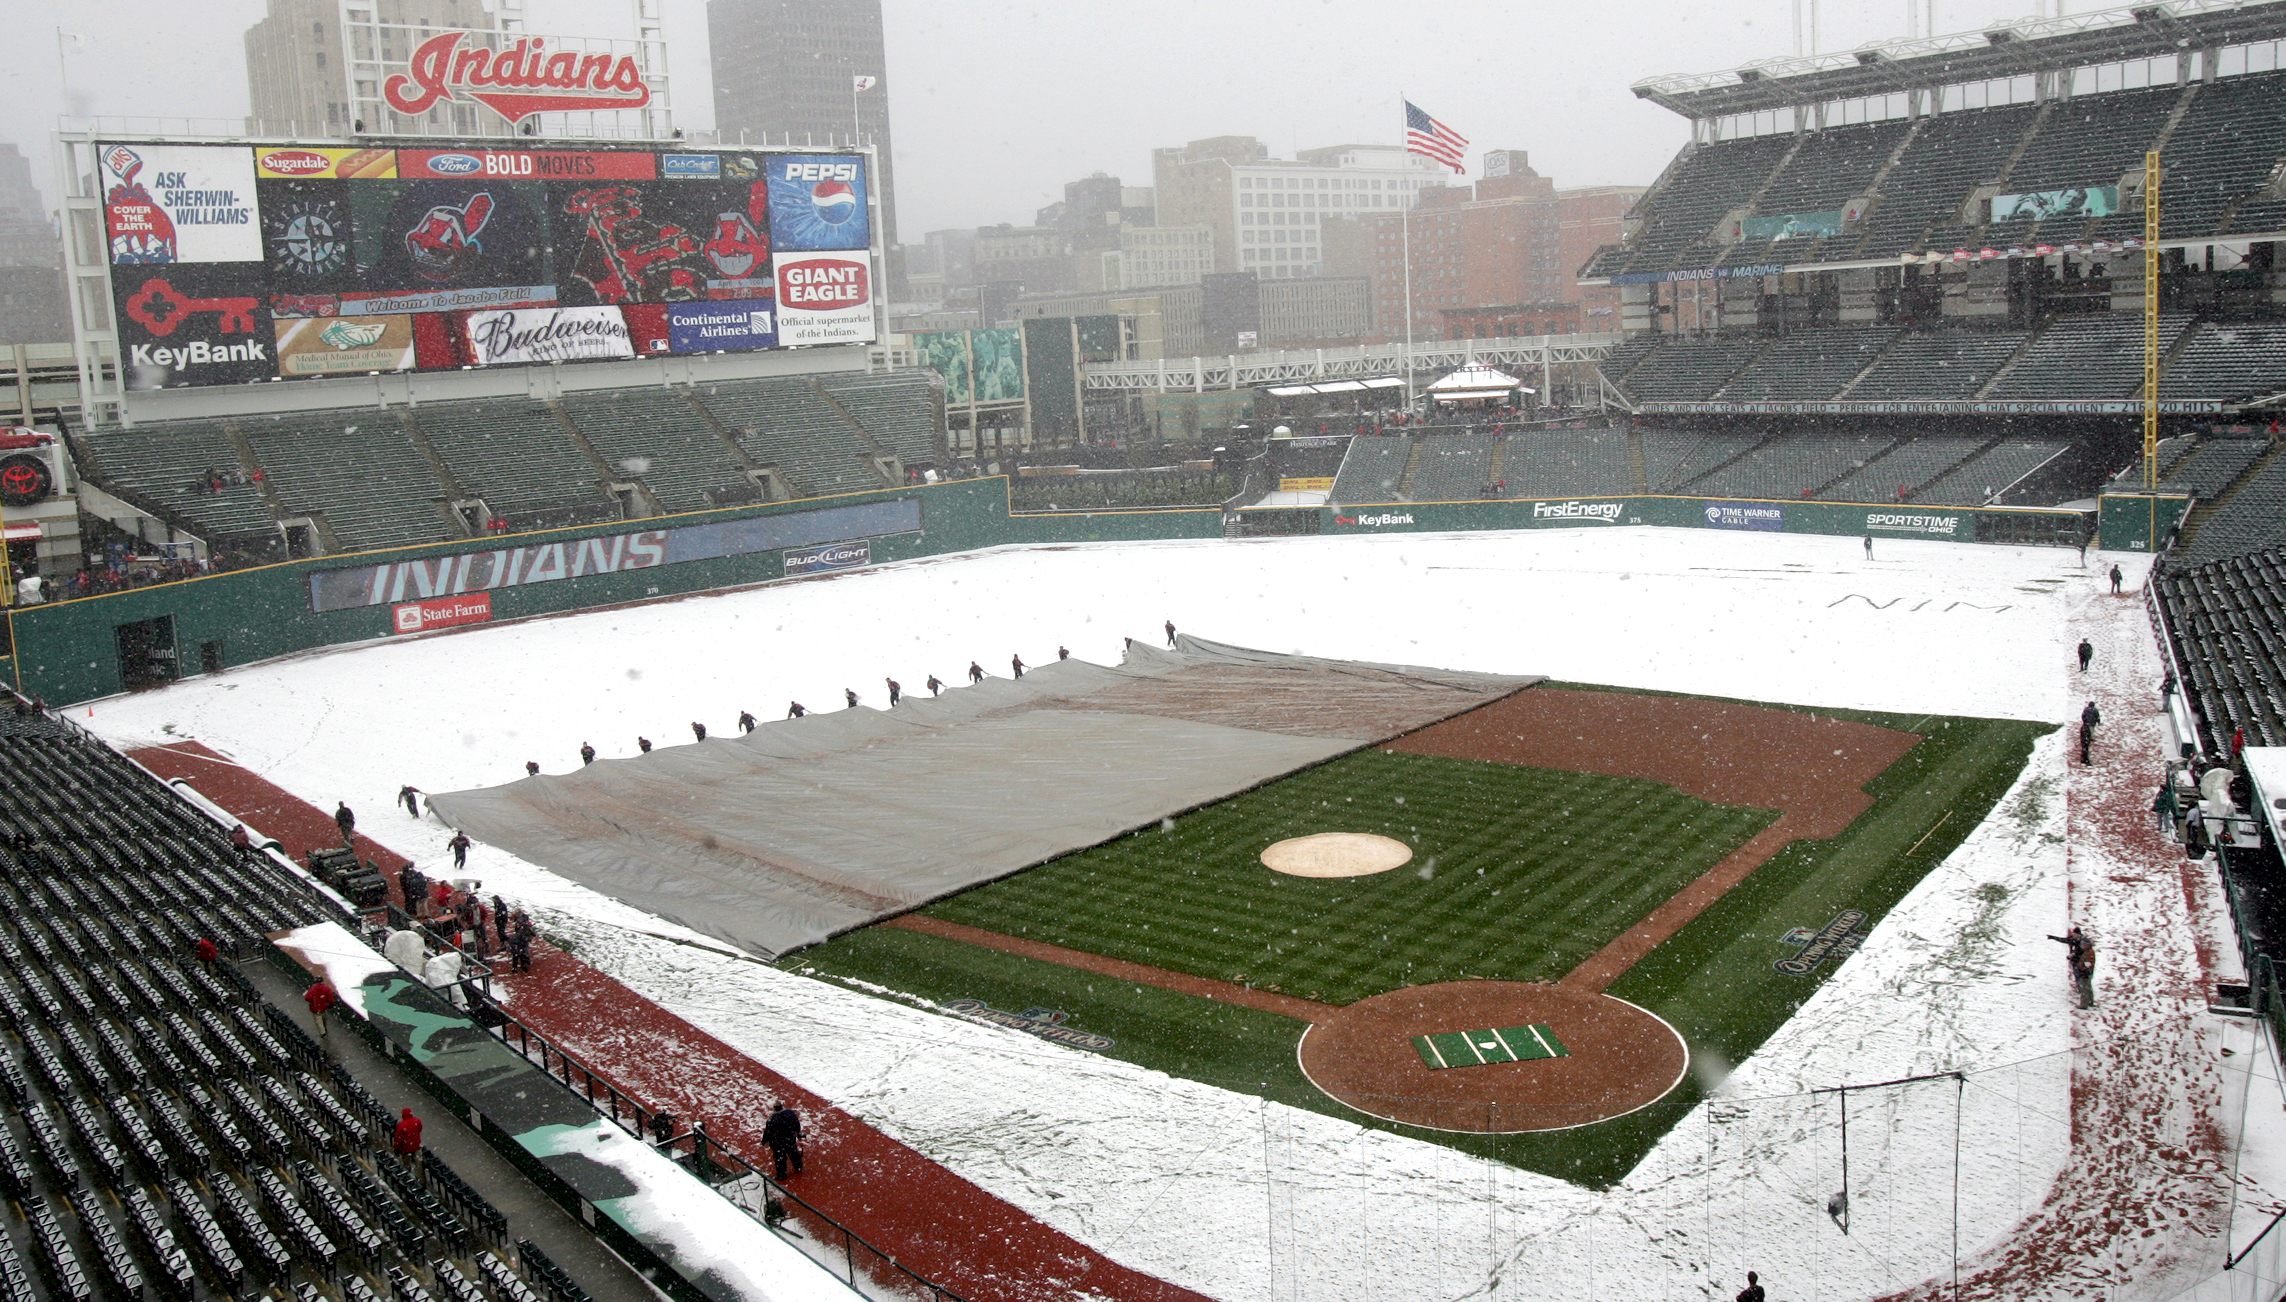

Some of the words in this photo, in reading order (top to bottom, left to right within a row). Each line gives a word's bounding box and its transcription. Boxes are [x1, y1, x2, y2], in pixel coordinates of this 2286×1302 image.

[384, 31, 650, 118] Indians
[264, 156, 329, 172] Sugardale
[438, 156, 473, 172] Ford
[486, 155, 532, 175] BOLD
[537, 156, 596, 175] MOVES
[785, 163, 858, 181] PEPSI
[155, 172, 187, 189] ASK
[164, 190, 240, 207] SHERWIN-
[113, 206, 152, 214] COVER
[176, 208, 249, 225] WILLIAMS
[274, 201, 342, 229] SEATTLE
[122, 214, 145, 222] THE
[116, 222, 153, 231] EARTH
[787, 267, 859, 285] GIANT
[1666, 268, 1714, 282] INDIANS
[366, 298, 428, 313] Welcome
[432, 295, 447, 307] To
[449, 290, 496, 305] Jacobs
[500, 287, 532, 301] Field
[790, 284, 859, 302] EAGLE
[672, 312, 748, 327] Continental
[781, 316, 814, 327] Official
[817, 314, 871, 327] supermarket
[475, 311, 629, 362] Budweiser
[700, 325, 749, 338] Airlines
[796, 329, 807, 338] of
[808, 328, 821, 337] the
[823, 327, 859, 338] Indians.
[561, 340, 575, 349] OF
[131, 339, 267, 371] KeyBank
[295, 352, 328, 364] Medical
[330, 351, 360, 362] Mutual
[362, 350, 371, 361] of
[296, 361, 323, 371] Home
[325, 360, 349, 370] Team
[1673, 404, 1691, 413] AND
[1720, 404, 1746, 413] SEATS
[1764, 404, 1798, 413] JACOBS
[1801, 404, 1827, 413] FIELD
[1839, 404, 1879, 413] PERFECT
[1883, 404, 1901, 413] FOR
[1906, 404, 1980, 413] ENTERTAINING
[1984, 404, 2011, 413] THAT
[2016, 403, 2059, 413] SPECIAL
[2066, 403, 2105, 413] CLIENT
[1533, 501, 1623, 518] FirstEnergy
[1722, 507, 1743, 517] TIME
[1743, 508, 1781, 519] WARNER
[1358, 513, 1414, 527] KeyBank
[1722, 517, 1749, 525] CABLE
[1866, 513, 1959, 528] SPORTSTIME
[1928, 526, 1954, 534] OHIO
[2130, 540, 2145, 549] 325
[785, 555, 820, 567] BUD
[825, 548, 868, 561] LIGHT
[369, 530, 667, 605] INDIANS
[423, 608, 453, 622] State
[454, 604, 488, 617] Farm
